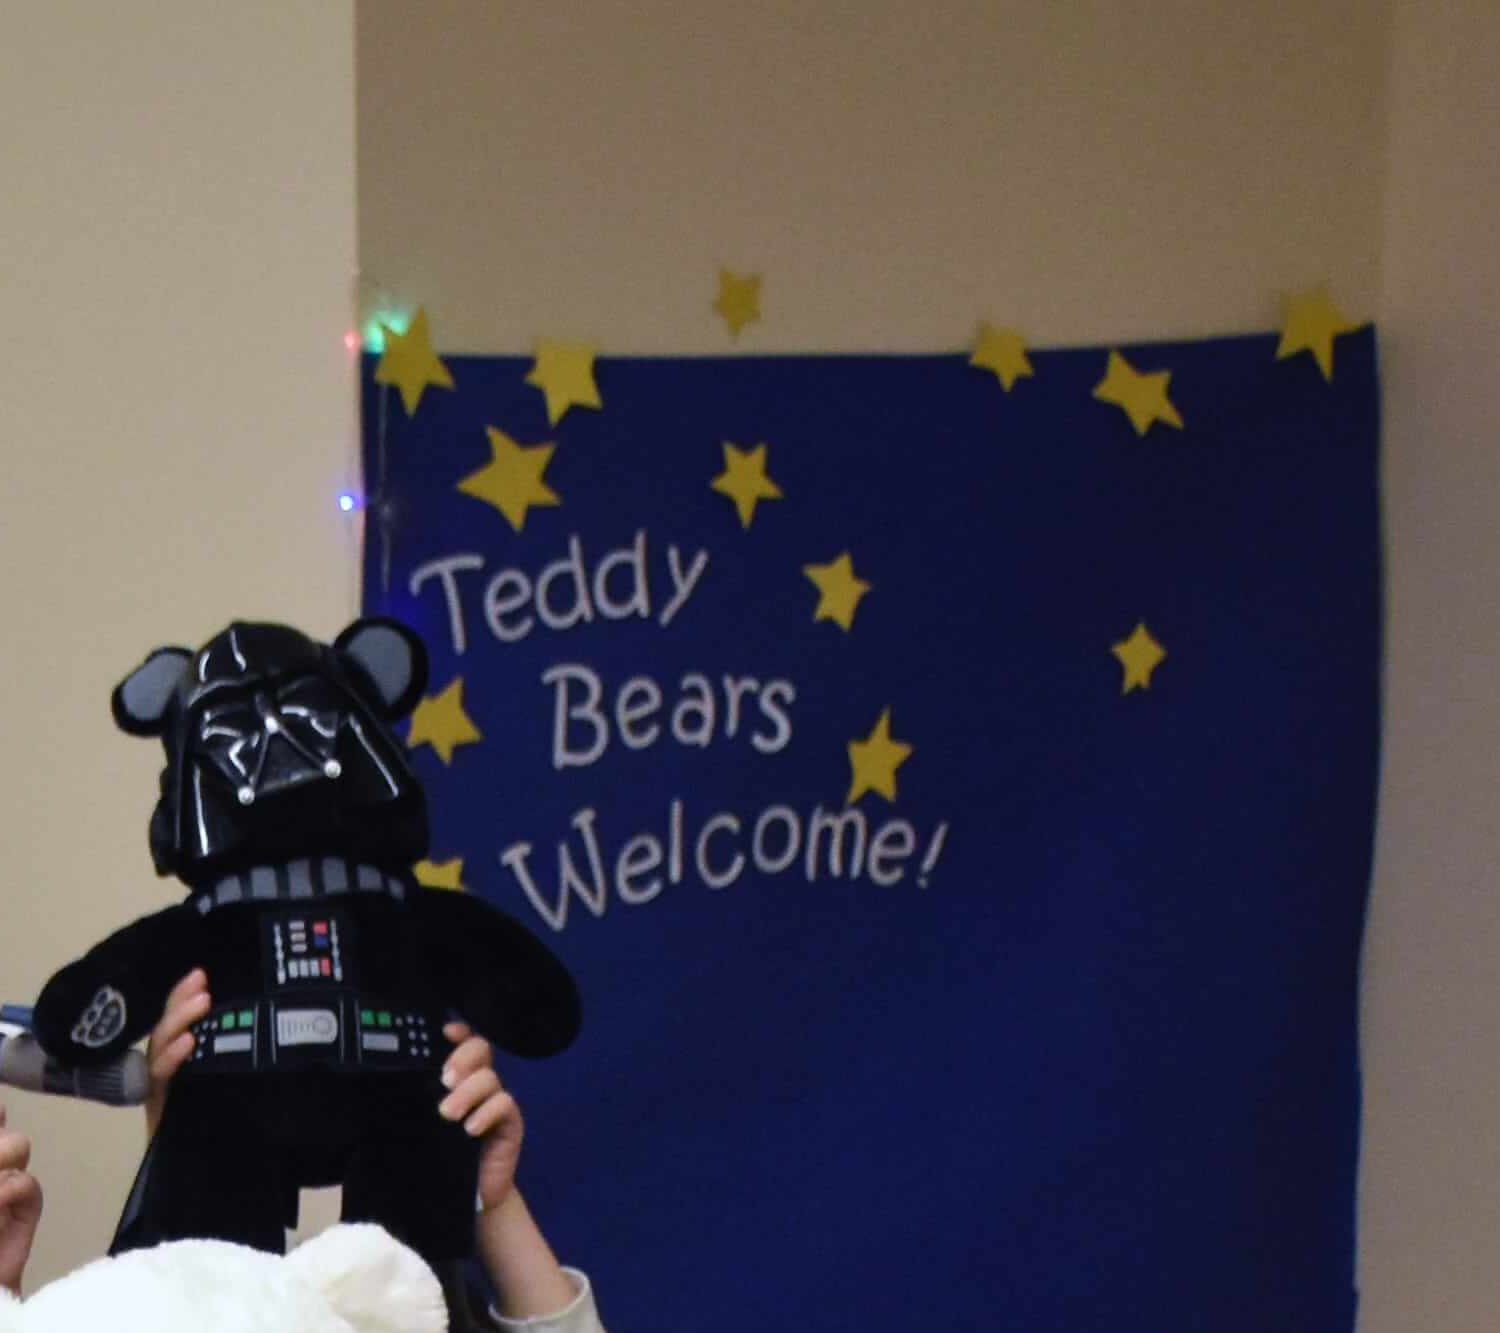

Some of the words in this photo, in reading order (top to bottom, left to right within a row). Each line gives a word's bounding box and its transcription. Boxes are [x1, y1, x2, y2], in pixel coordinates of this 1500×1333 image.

[409, 529, 709, 654] Teddy
[540, 663, 796, 770] Bears
[501, 799, 948, 932] Welcome!
